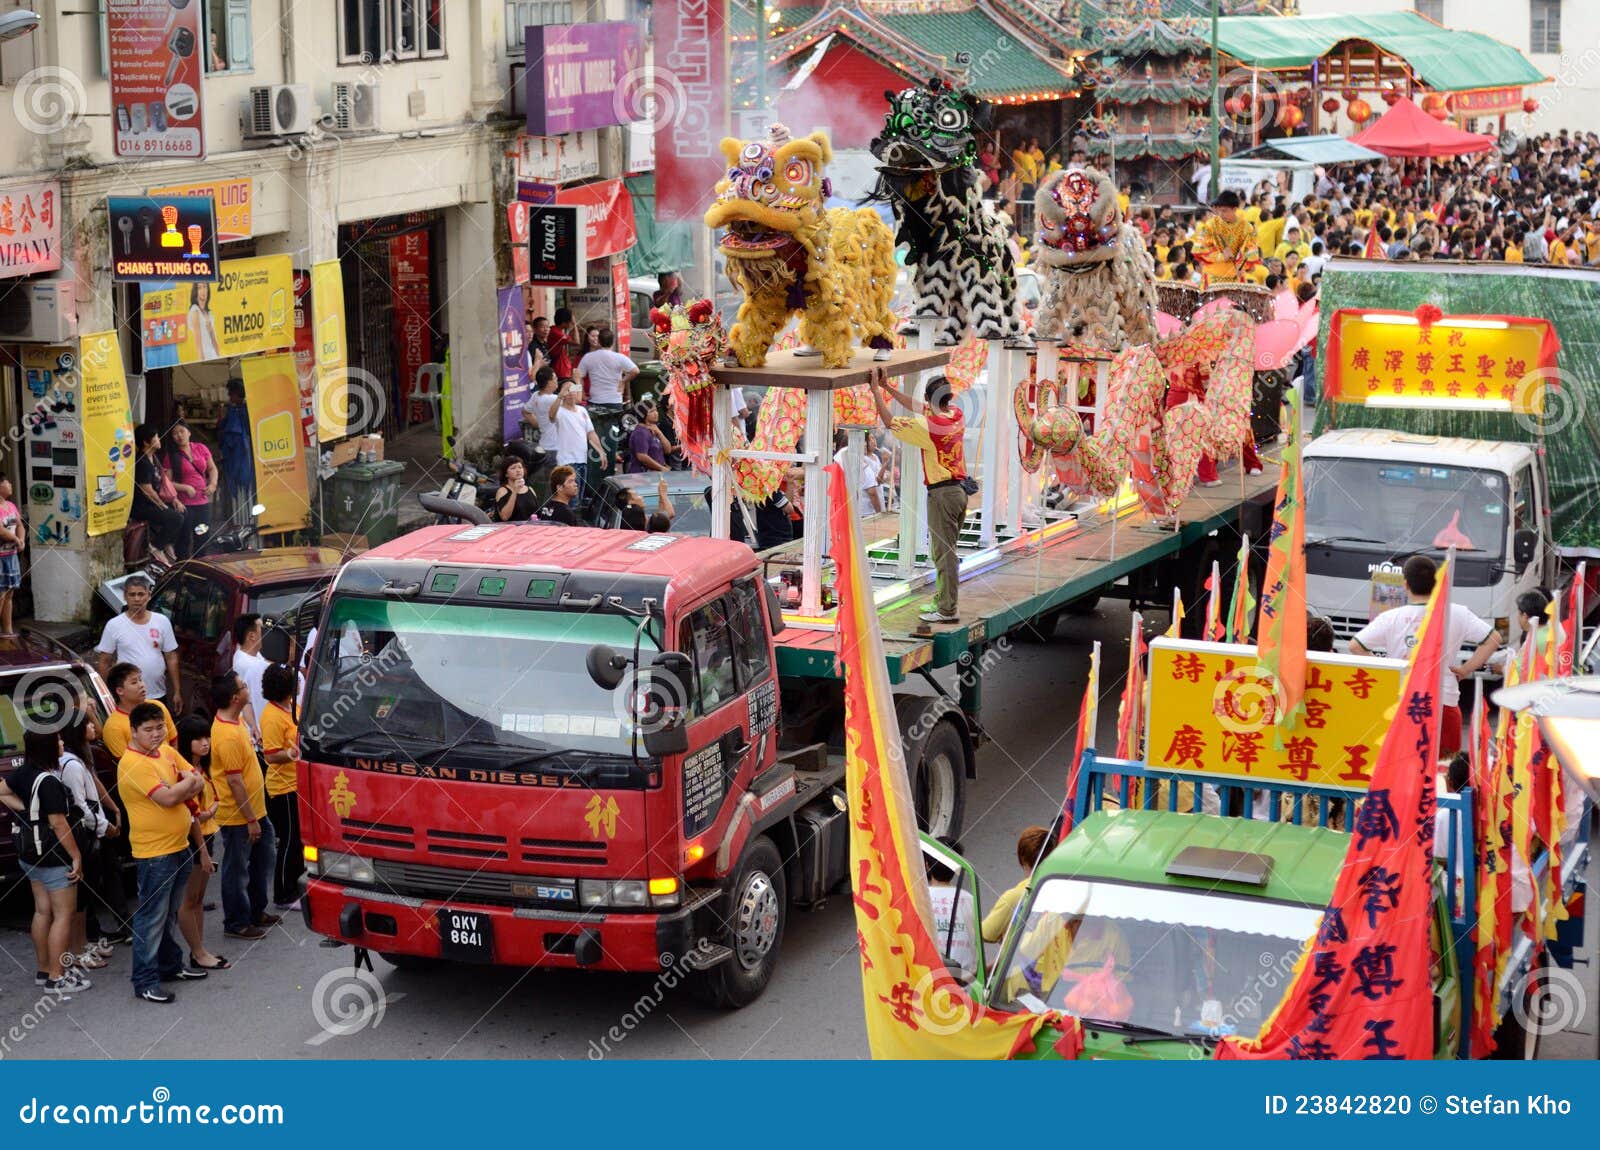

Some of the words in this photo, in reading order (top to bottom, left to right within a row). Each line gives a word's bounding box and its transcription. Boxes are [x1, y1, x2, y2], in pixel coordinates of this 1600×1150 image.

[120, 139, 141, 151] 016
[144, 139, 193, 151] 8916668
[221, 184, 248, 206] LING
[541, 214, 556, 261] Touch
[117, 262, 153, 275] CHANG
[155, 262, 191, 275] THUNG
[193, 262, 212, 275] CO.
[217, 270, 244, 292] 20%
[223, 311, 264, 335] RM200
[264, 438, 289, 452] DiGi
[1171, 652, 1378, 699] 詩山山寺
[1164, 724, 1371, 782] 廣澤尊王
[356, 758, 457, 779] NISSAN
[470, 770, 582, 788] DIESEL
[451, 915, 478, 931] QKV
[450, 930, 482, 947] 8641
